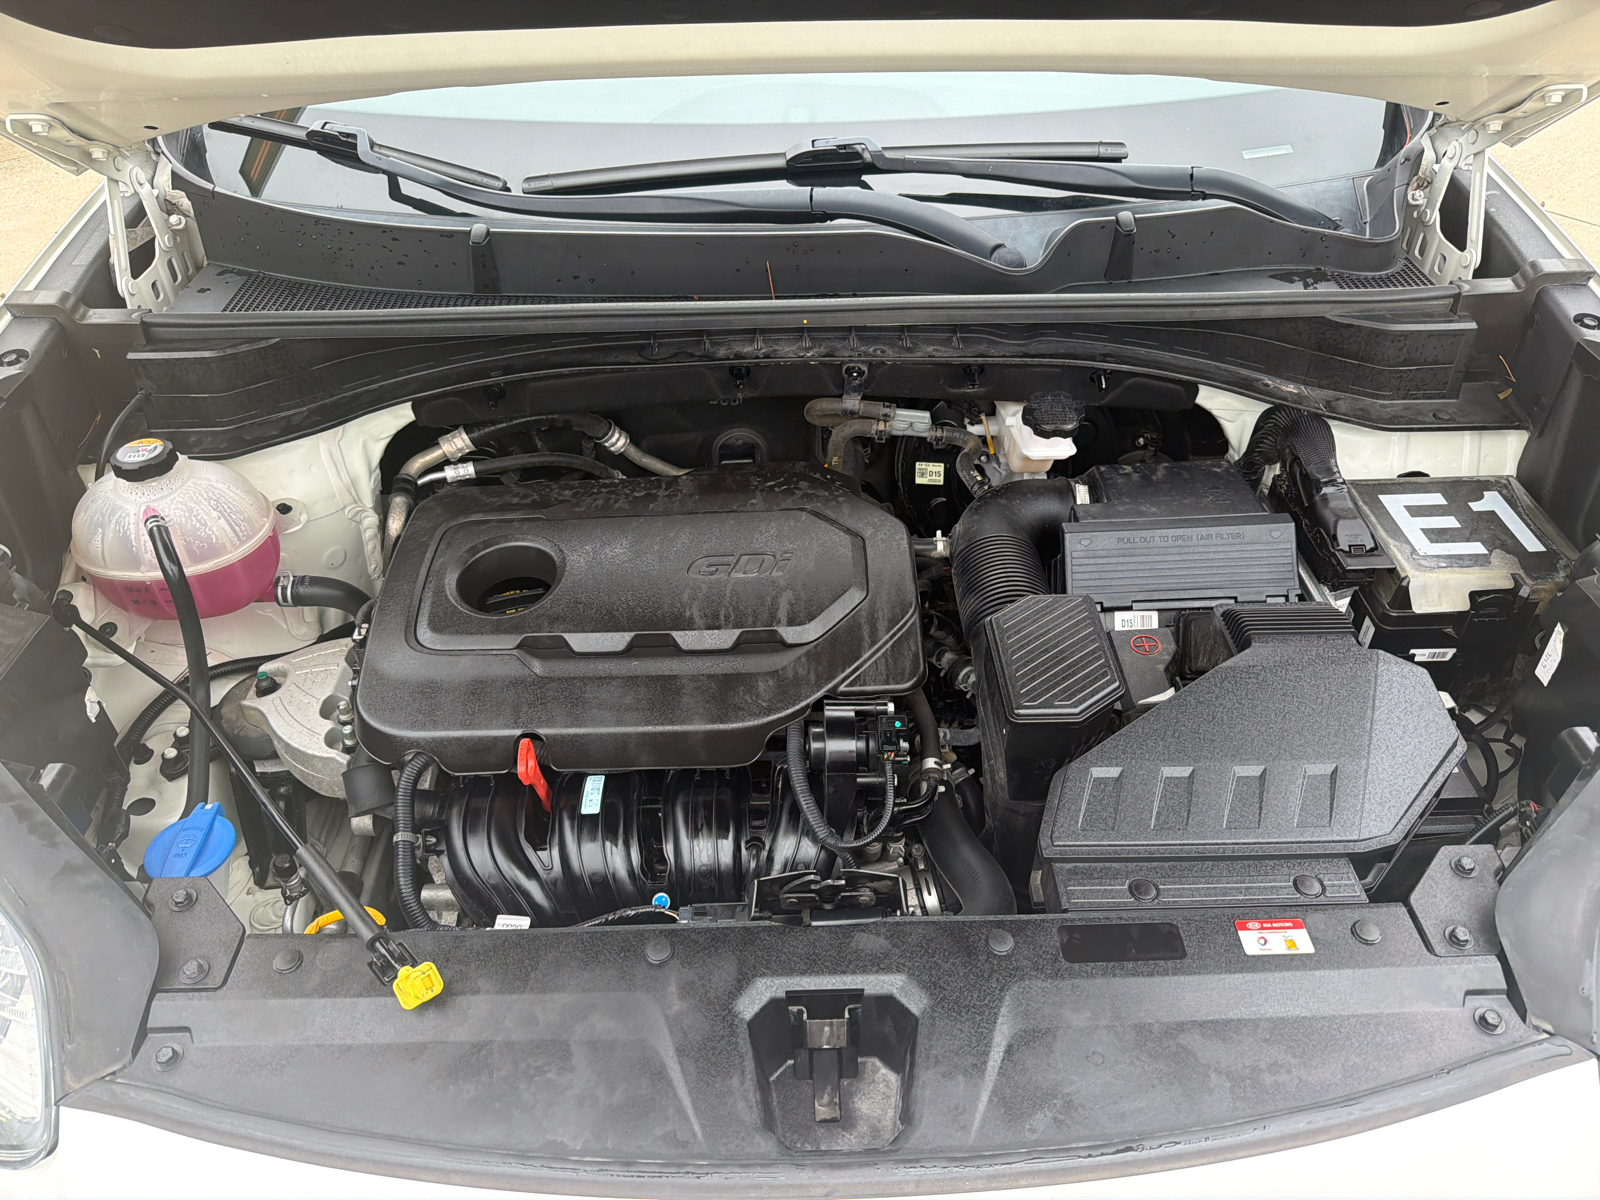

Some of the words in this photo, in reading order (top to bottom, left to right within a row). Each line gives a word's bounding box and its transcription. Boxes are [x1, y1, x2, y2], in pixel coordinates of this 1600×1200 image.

[928, 470, 942, 478] D15
[1378, 490, 1547, 556] E1
[1117, 537, 1138, 545] PULL
[1139, 536, 1157, 544] OUT
[1158, 535, 1169, 543] TO
[1170, 534, 1193, 542] OPEN
[686, 550, 794, 578] GDi
[1121, 619, 1134, 628] D15
